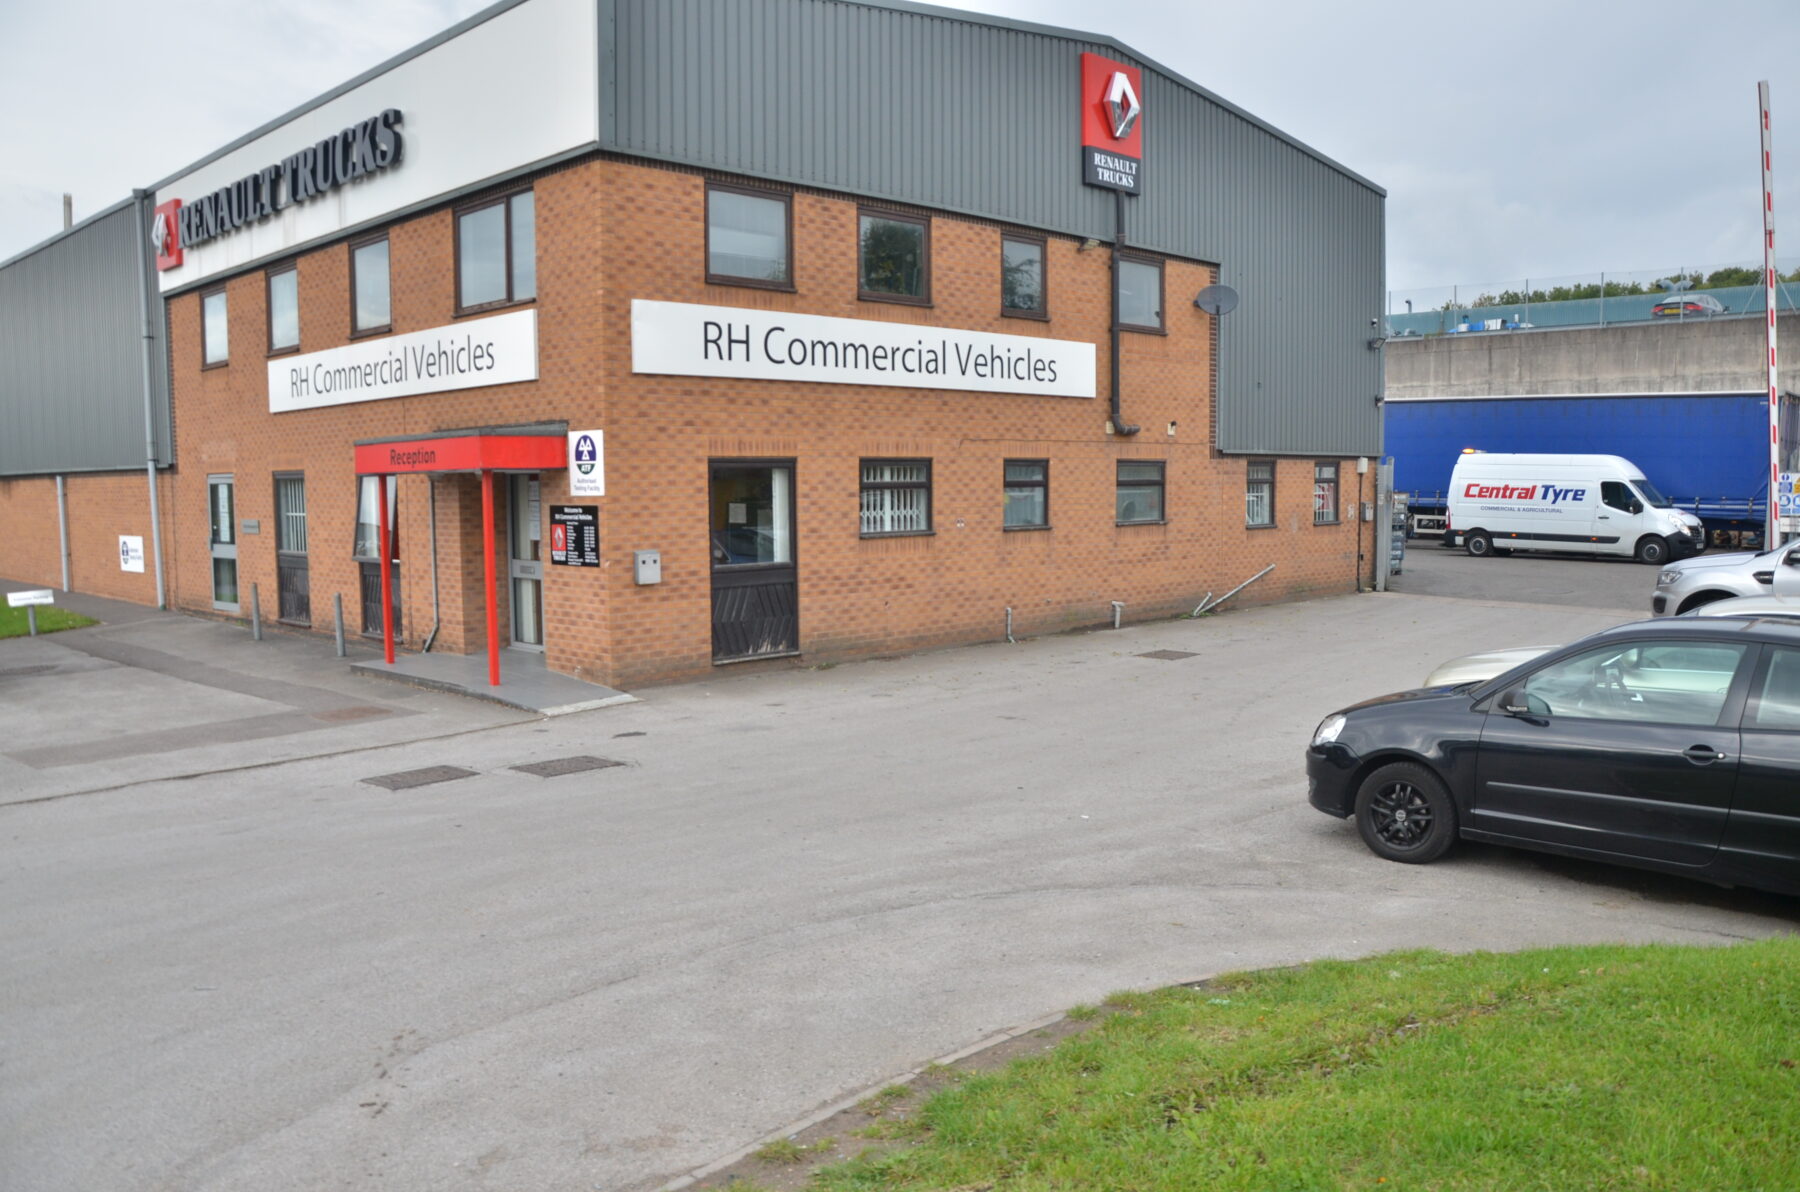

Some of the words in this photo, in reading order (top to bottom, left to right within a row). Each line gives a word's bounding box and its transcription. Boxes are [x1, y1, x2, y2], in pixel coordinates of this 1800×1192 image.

[1093, 152, 1138, 175] RENAULT
[175, 162, 282, 250] RENAULT
[279, 108, 404, 208] TRUCKS
[1096, 167, 1134, 188] TRUCKS
[702, 320, 752, 363] RH
[763, 326, 947, 375] Commercial
[955, 342, 1058, 384] Vehicles
[290, 366, 310, 398] RH
[313, 352, 409, 395] Commercial
[411, 335, 496, 380] Vehicles
[390, 447, 436, 468] Reception
[1464, 483, 1537, 500] Central
[1541, 484, 1586, 504] Tyre
